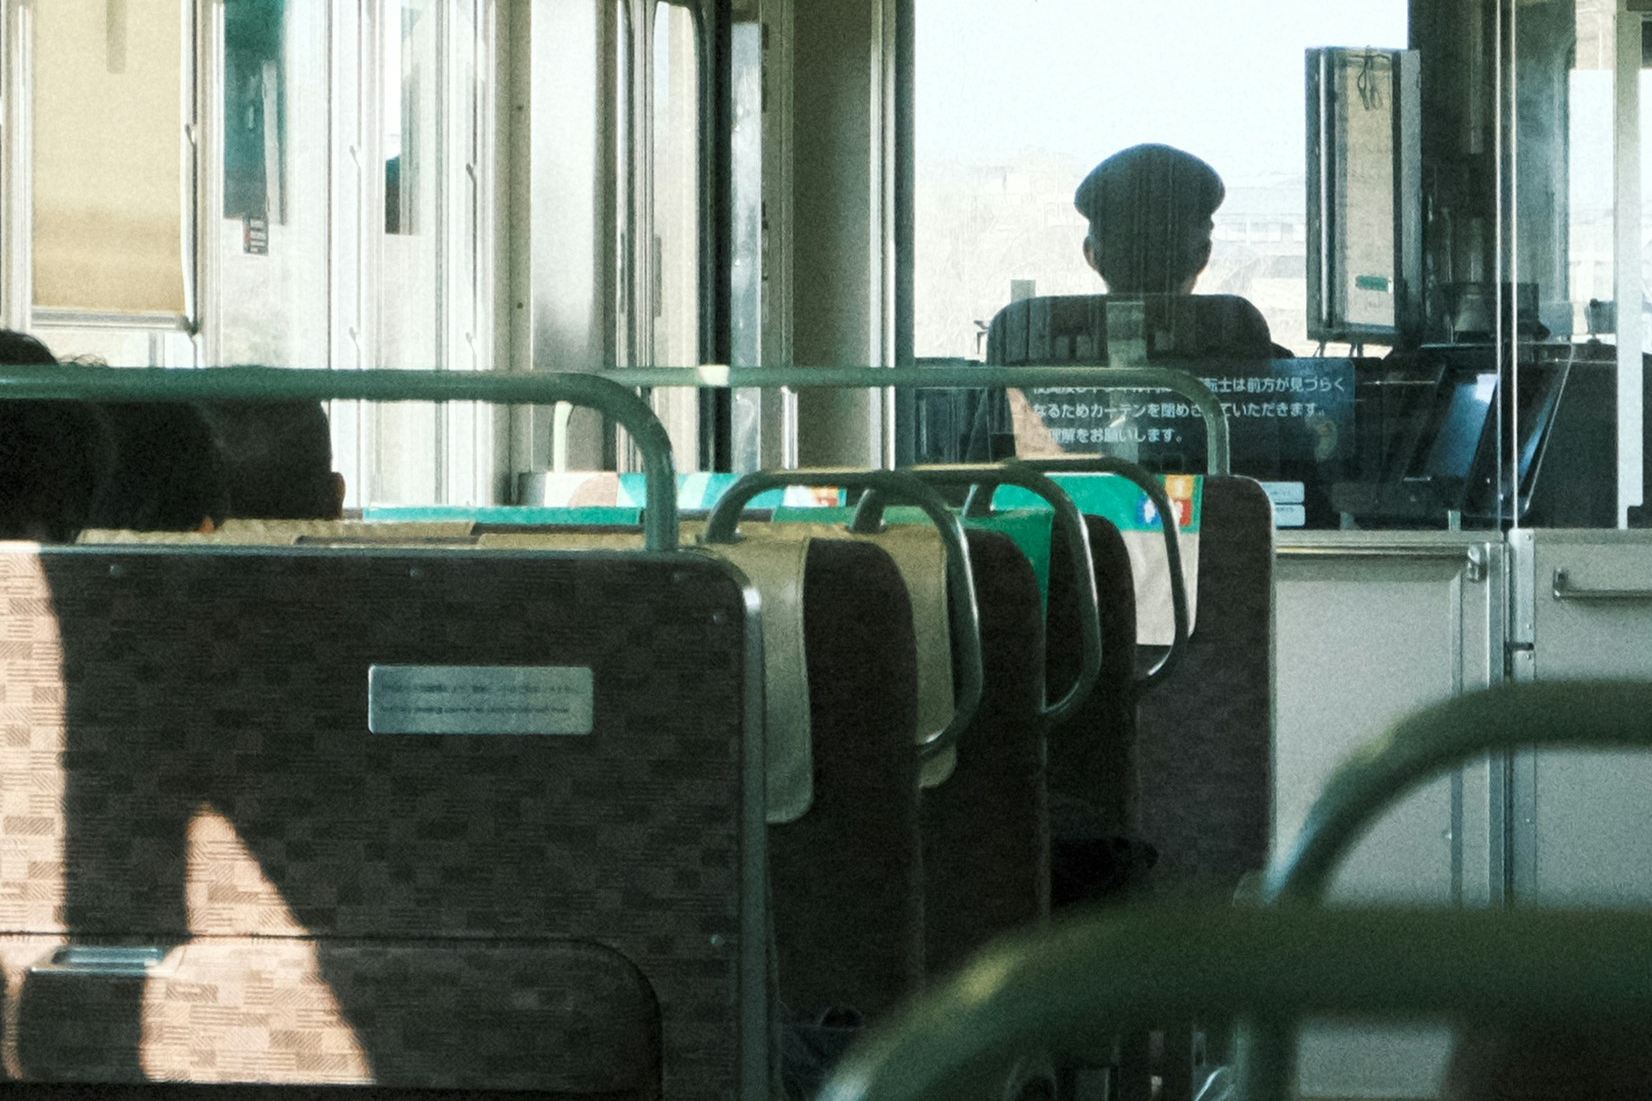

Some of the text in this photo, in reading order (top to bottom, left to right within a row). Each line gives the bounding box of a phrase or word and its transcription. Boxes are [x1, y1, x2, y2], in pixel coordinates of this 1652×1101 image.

[1034, 403, 1325, 418] なるためカーテンを閉めさていただきます。
